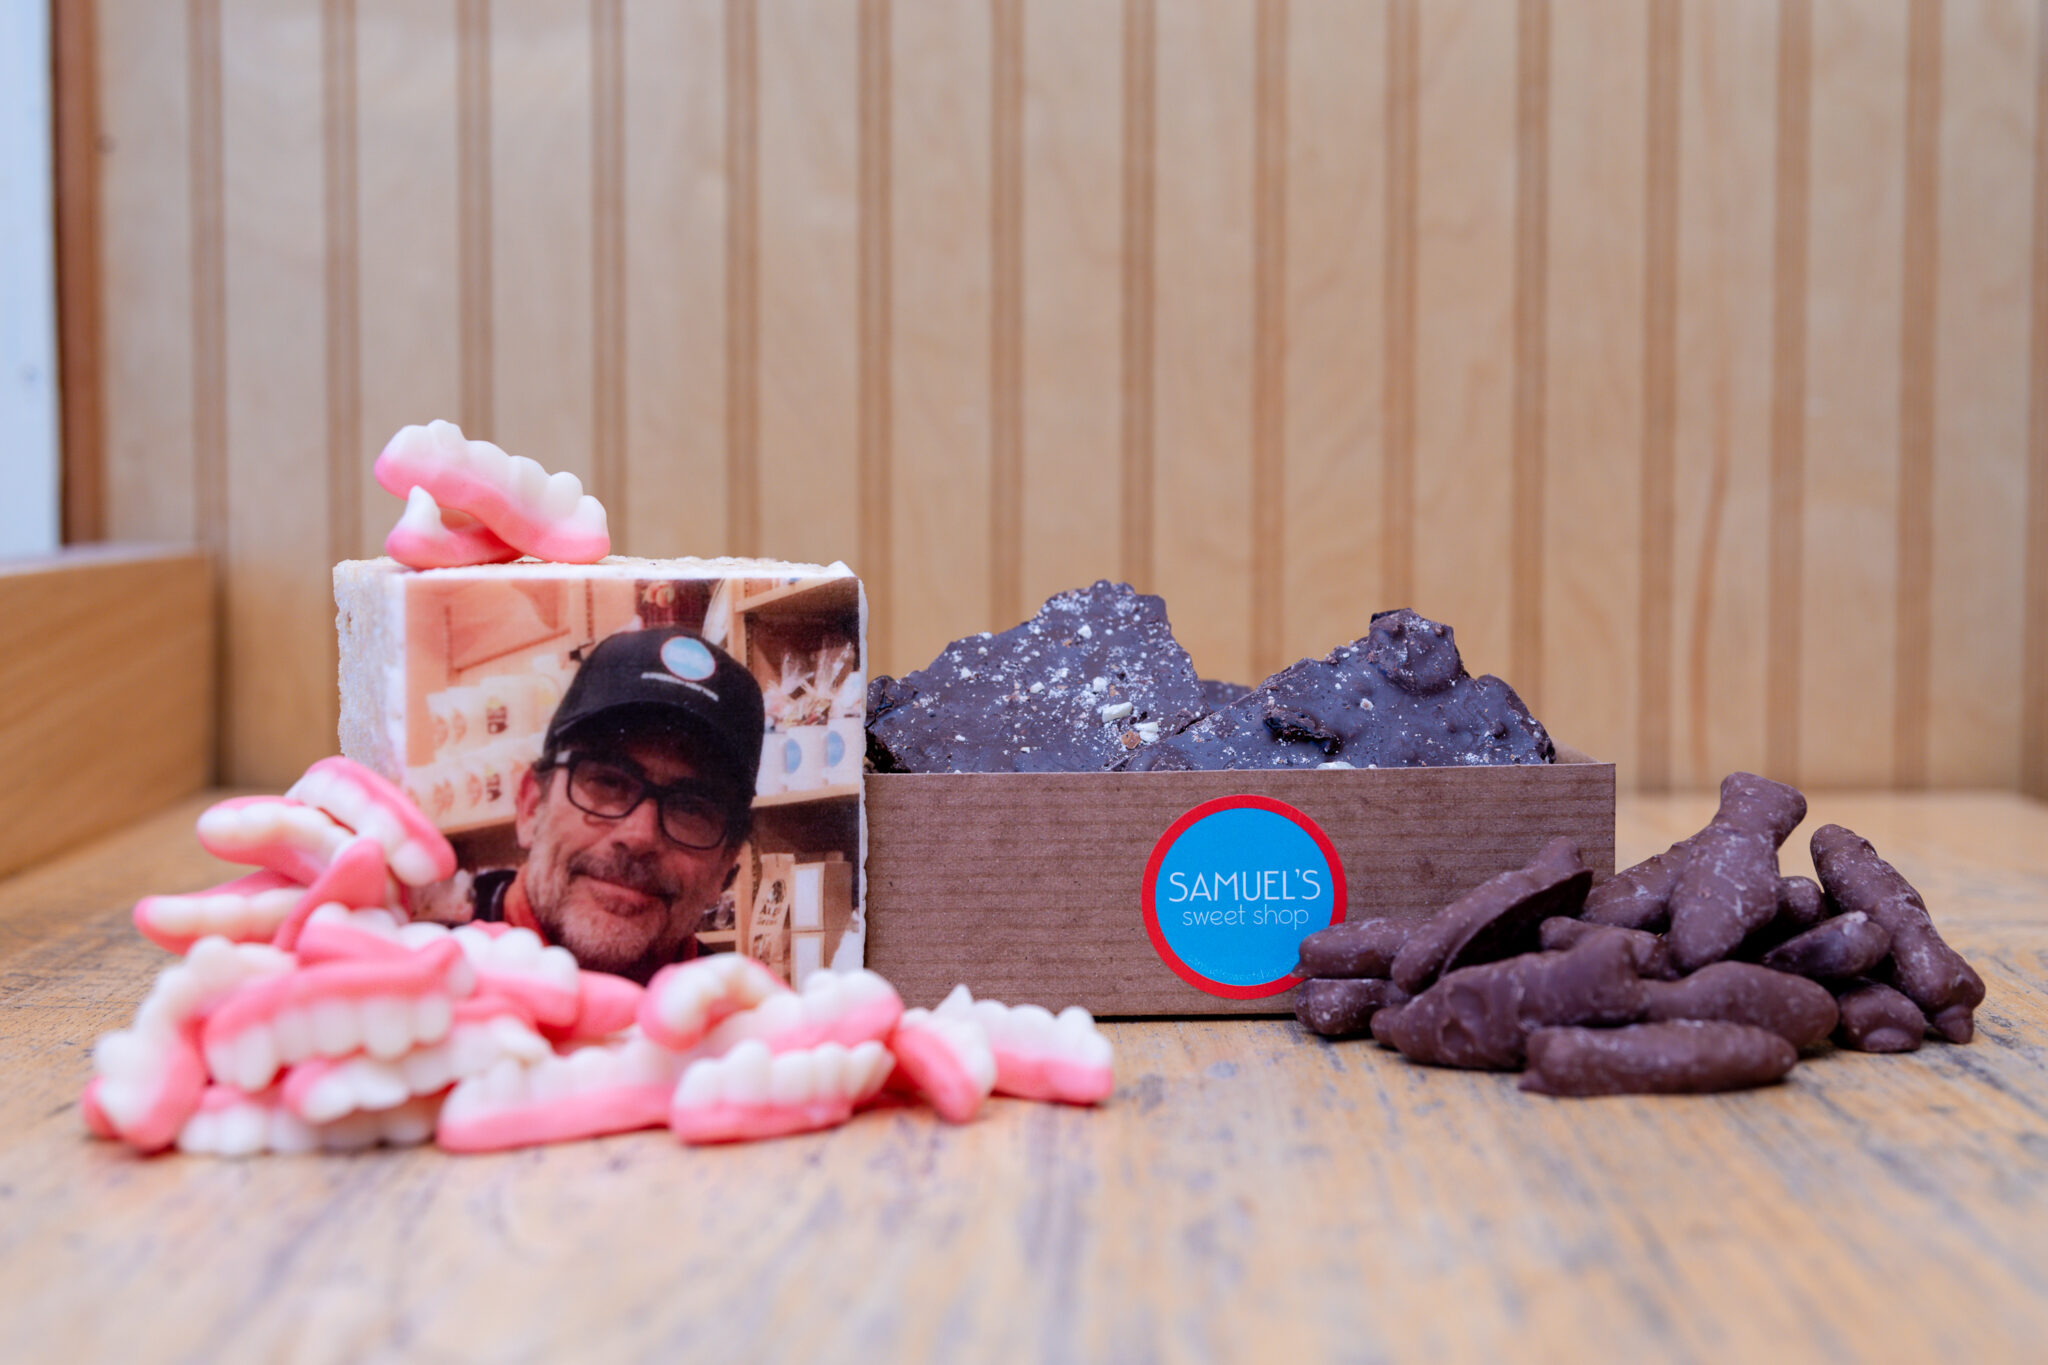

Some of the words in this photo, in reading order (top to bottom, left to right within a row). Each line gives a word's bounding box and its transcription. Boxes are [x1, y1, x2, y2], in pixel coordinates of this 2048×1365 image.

[1169, 868, 1321, 902] SAMUEL'S
[1182, 904, 1246, 926] sweet
[1253, 903, 1310, 930] shop
